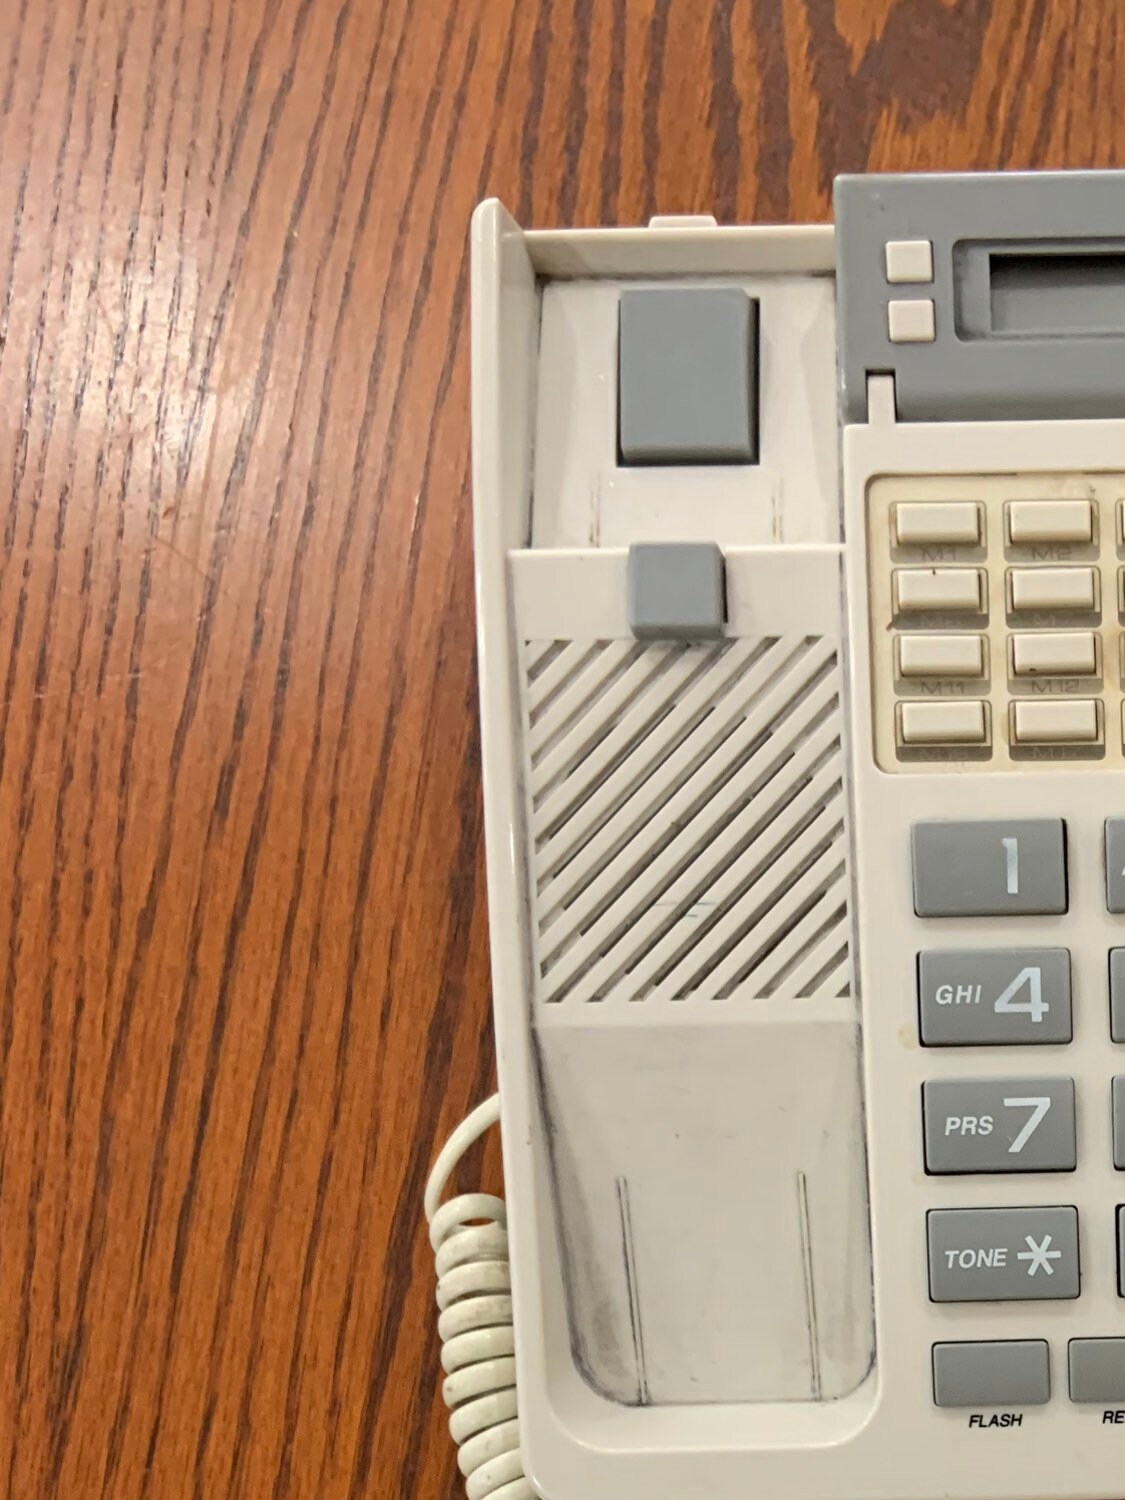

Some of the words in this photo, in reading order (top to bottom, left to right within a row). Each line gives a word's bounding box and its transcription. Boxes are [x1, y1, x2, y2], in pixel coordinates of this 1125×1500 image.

[920, 680, 965, 694] M11
[1031, 679, 1080, 693] M12
[1001, 837, 1019, 894] 1
[935, 984, 982, 1005] GHI
[994, 966, 1050, 1023] 4
[944, 1115, 994, 1136] PRS
[1003, 1096, 1051, 1153] 7
[944, 1247, 1009, 1269] TONE
[968, 1413, 1023, 1428] FLASH
